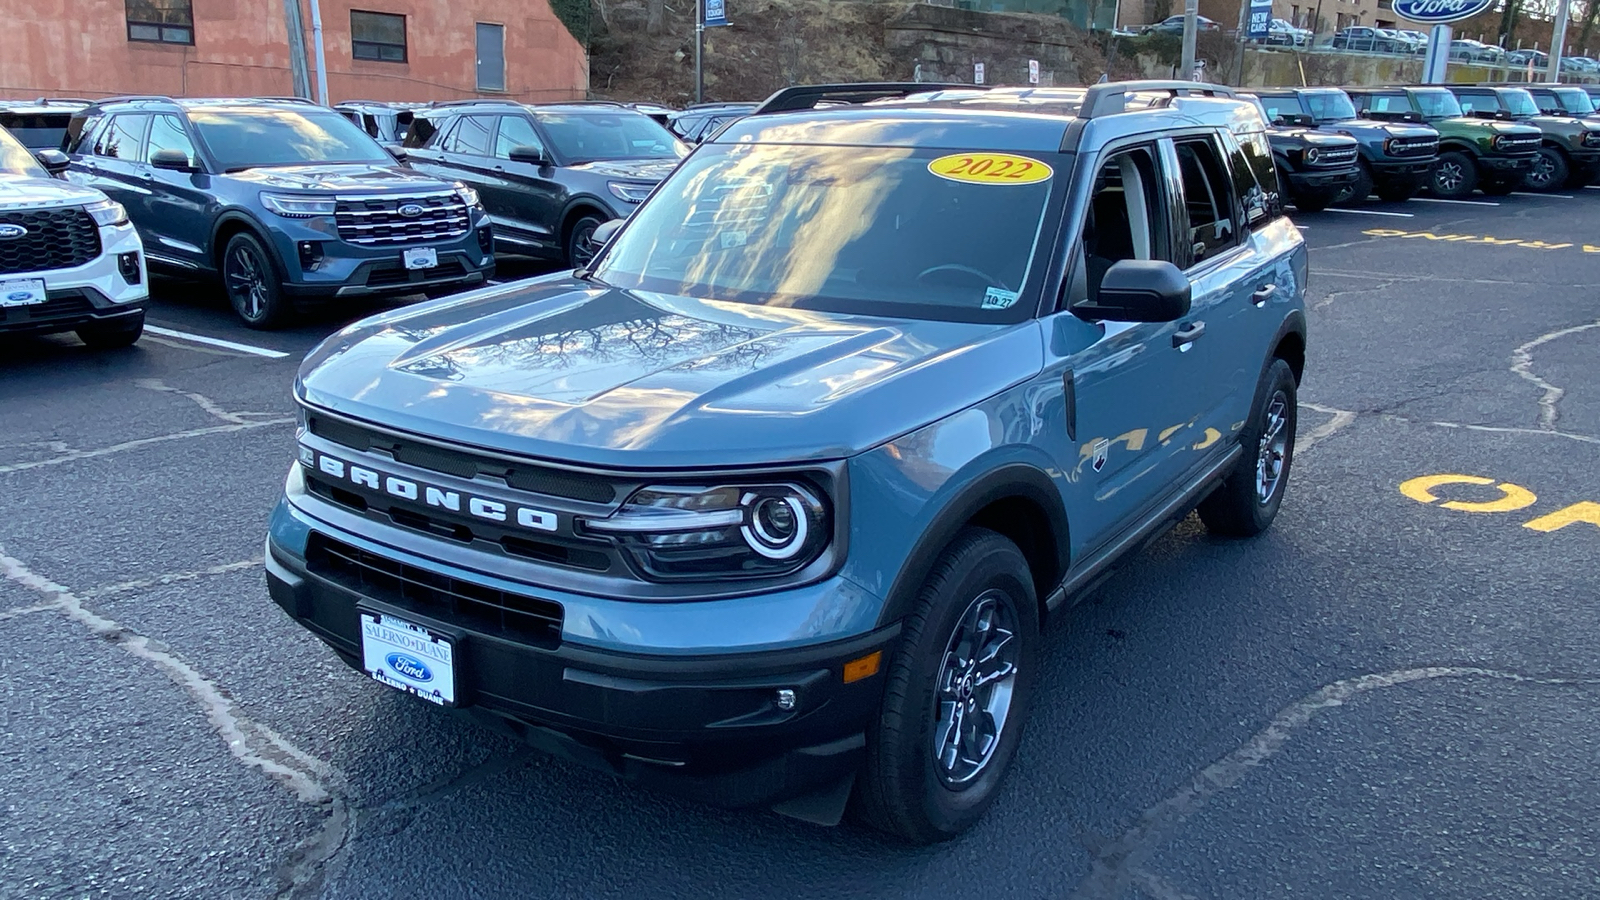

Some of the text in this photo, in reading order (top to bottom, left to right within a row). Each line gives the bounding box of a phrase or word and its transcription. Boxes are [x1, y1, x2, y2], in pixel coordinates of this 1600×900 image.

[1410, 0, 1467, 14] Ford
[1251, 23, 1267, 32] CARS
[1252, 12, 1268, 23] NEW
[945, 158, 1033, 178] 2022
[986, 294, 1013, 308] 10 27
[319, 455, 558, 532] BRONCO
[365, 623, 411, 648] SALERNO
[415, 640, 450, 662] DUANE
[395, 656, 425, 679] Ford
[372, 672, 444, 706] SALERNO DUANE
